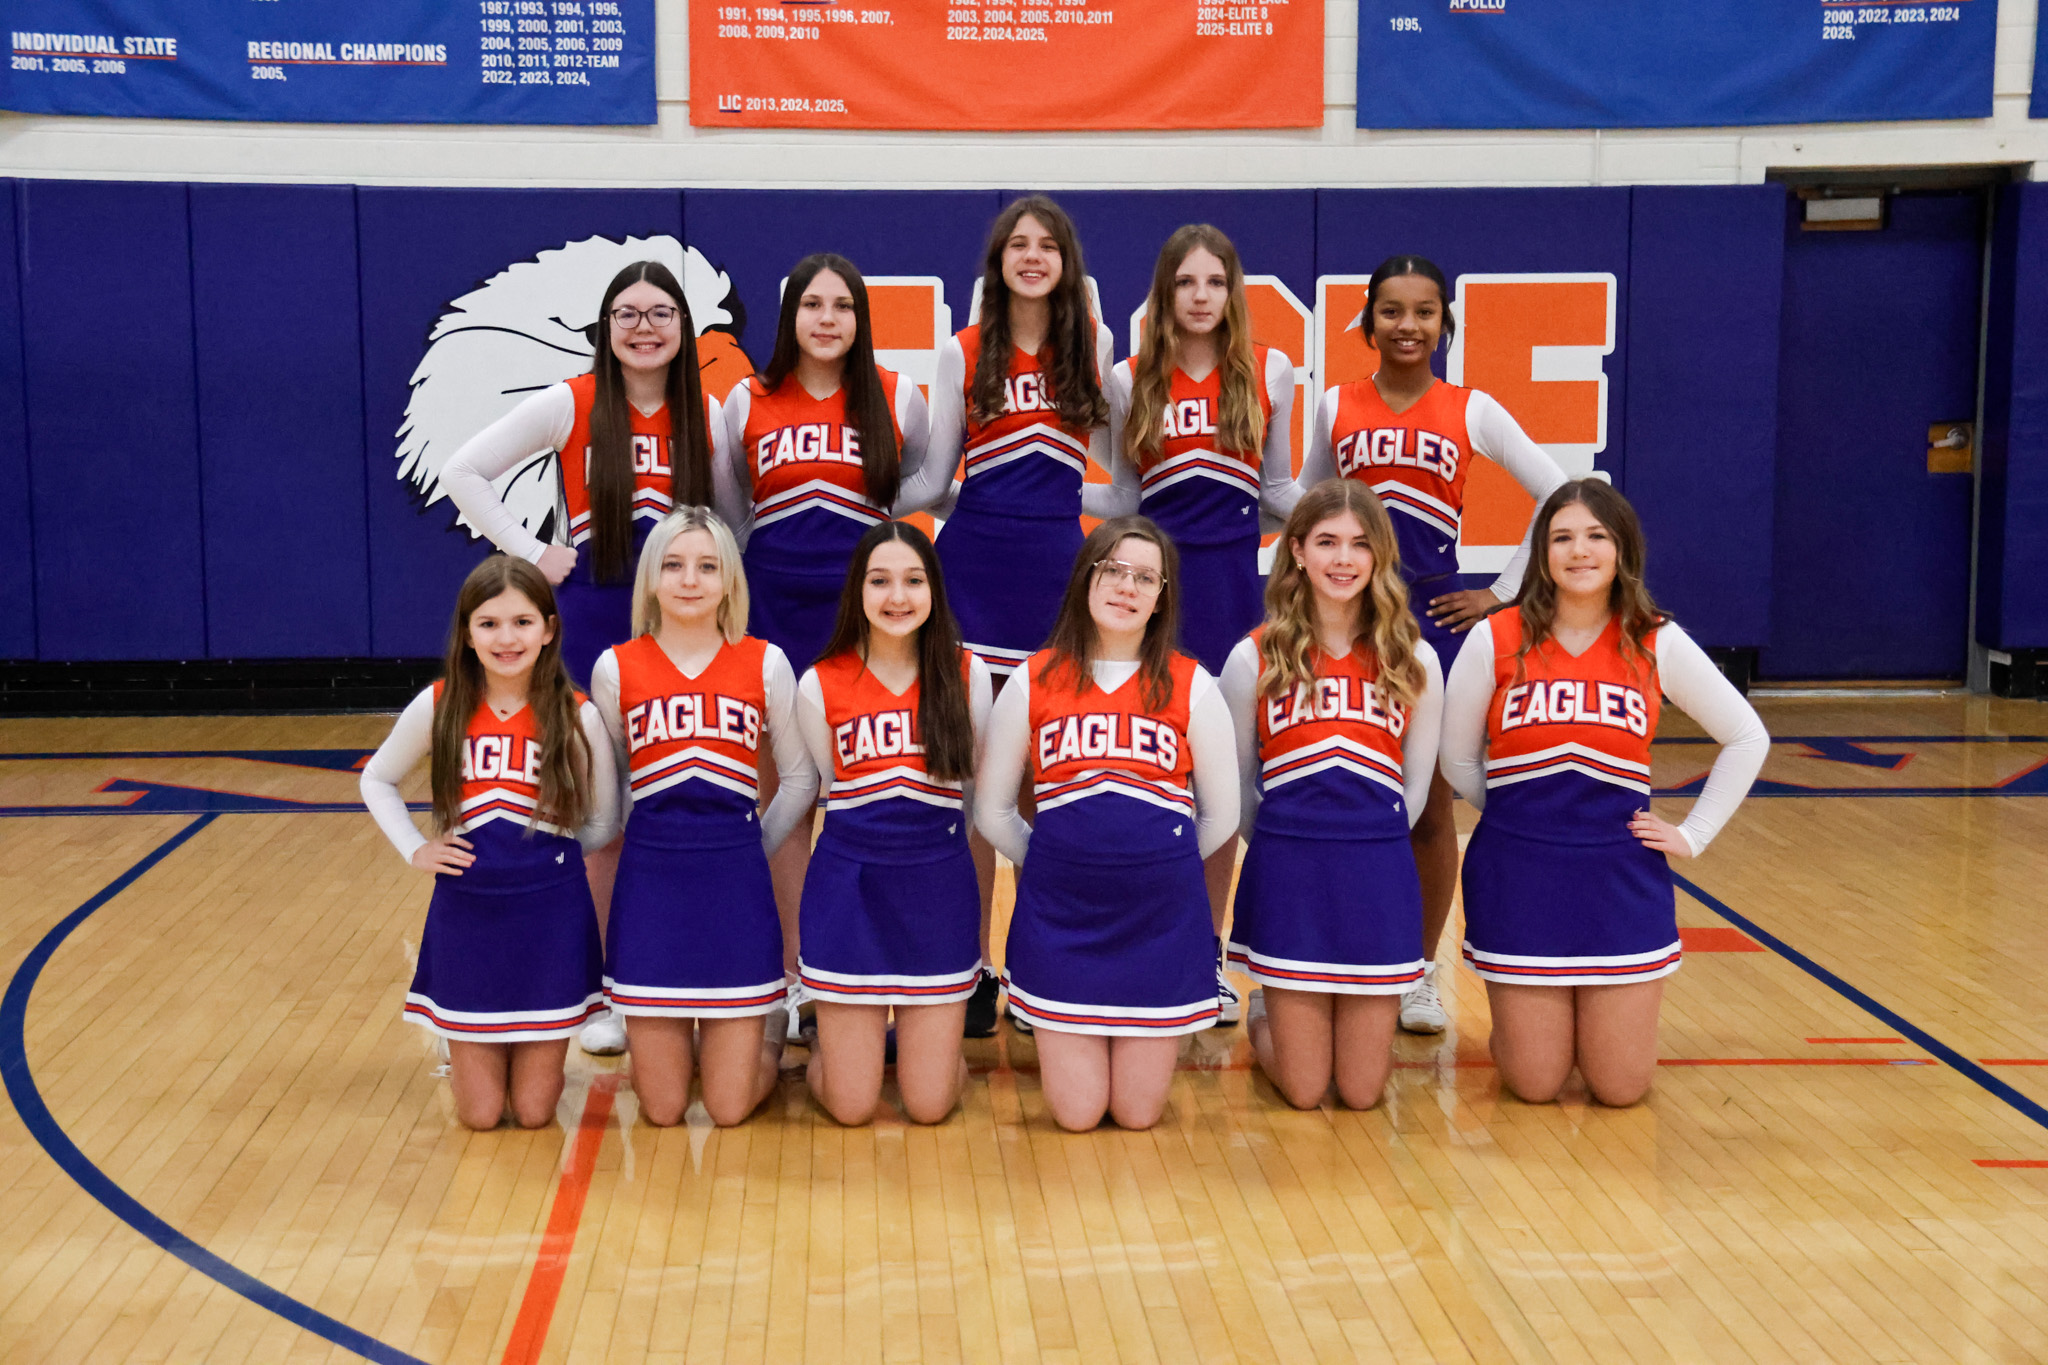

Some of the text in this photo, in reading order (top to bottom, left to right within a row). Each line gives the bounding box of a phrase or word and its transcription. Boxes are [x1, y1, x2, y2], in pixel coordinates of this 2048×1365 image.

[551, 2, 584, 17] 1994,
[588, 2, 621, 17] 1996,
[718, 7, 751, 21] 1991,
[756, 8, 788, 23] 1994,
[861, 10, 894, 25] 2007,
[948, 10, 980, 24] 2003,
[984, 10, 1016, 24] 2004,
[1261, 7, 1268, 19] 8
[480, 19, 625, 34] 1999, 2000, 2001, 2003,
[718, 24, 751, 39] 2008,
[1266, 22, 1273, 35] 8
[1390, 18, 1422, 32] 1995,
[1823, 26, 1855, 40] 2025,
[12, 32, 177, 55] INDIVIDUAL STATE
[481, 37, 622, 52] 2004, 2005, 2006, 2009
[248, 42, 446, 63] REGIONAL CHAMPIONS
[11, 56, 126, 74] 2001, 2005, 2006
[482, 54, 619, 68] 2010, 2011, 2012-TEAM
[252, 66, 287, 81] 2005,
[482, 70, 590, 86] 2022, 2023, 2024,
[719, 95, 741, 110] LIC
[757, 423, 864, 479] EAGLE
[1336, 427, 1460, 484] EAGLES
[1501, 679, 1649, 738] EAGLES
[627, 693, 762, 753] EAGLES
[836, 710, 928, 769] EAGL
[1039, 713, 1178, 774] EAGLES
[461, 735, 543, 785] AGLE
